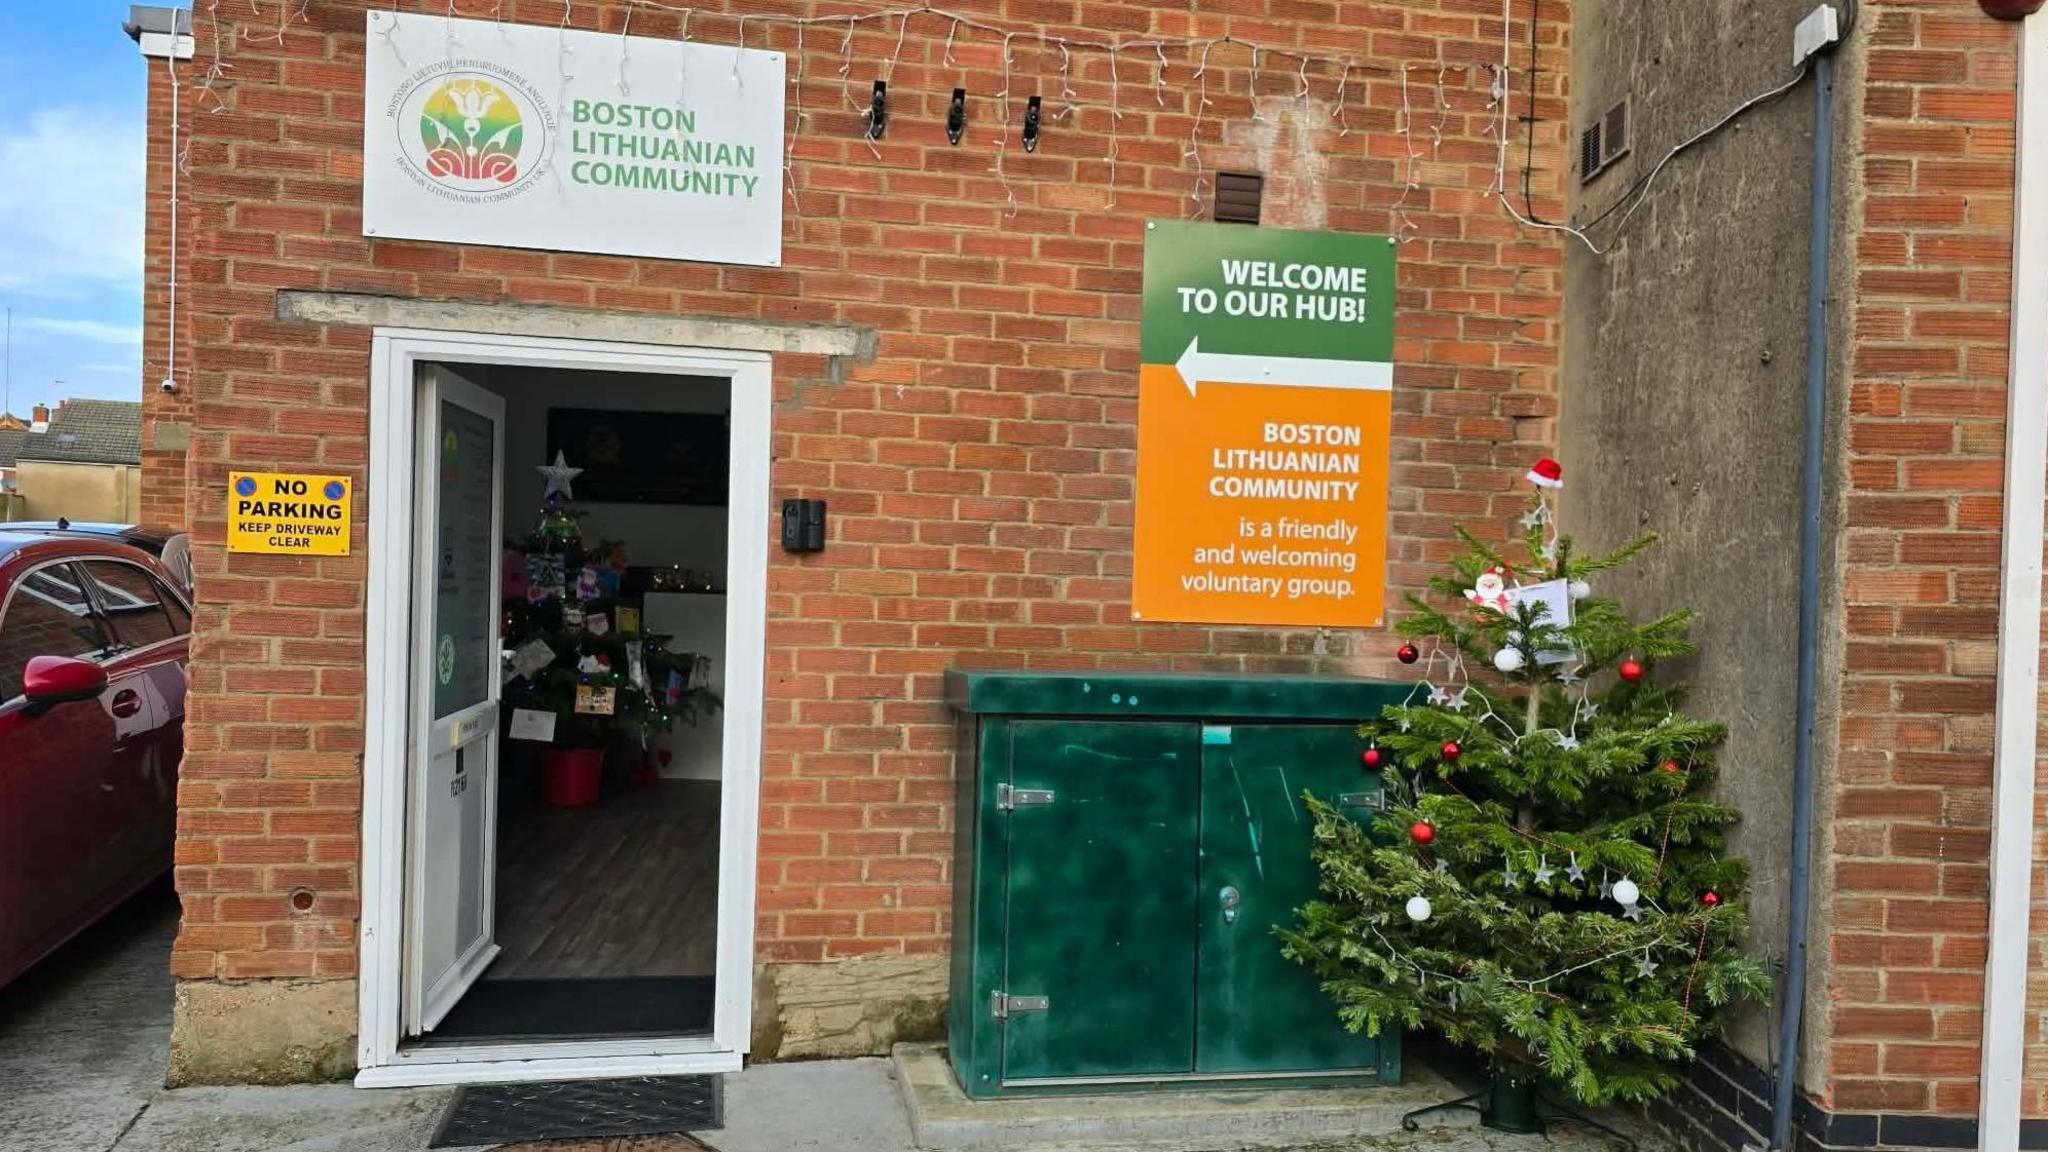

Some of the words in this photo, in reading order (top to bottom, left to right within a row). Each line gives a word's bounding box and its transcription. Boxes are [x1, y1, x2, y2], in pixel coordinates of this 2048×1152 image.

[573, 100, 695, 133] BOSTON
[573, 130, 755, 168] LITHUANIAN
[396, 156, 426, 187] BOSTON
[426, 184, 481, 204] LITHUANIAN
[483, 180, 534, 203] COMMUNITY
[571, 160, 759, 198] COMMUNITY
[1221, 259, 1367, 293] WELCOME
[1177, 287, 1218, 314] TO
[1224, 290, 1288, 318] OUR
[1295, 294, 1366, 323] HUB!
[1263, 422, 1361, 446] BOSTON
[1213, 448, 1360, 474] LITHUANIAN
[275, 479, 308, 496] NO
[1209, 476, 1359, 502] COMMUNITY
[238, 500, 342, 520] PARKING
[238, 522, 272, 533] KEEP
[276, 523, 342, 536] DRIVEWAY
[268, 536, 311, 548] CLEAR
[1239, 516, 1255, 537] is
[1260, 522, 1272, 537] a
[1277, 516, 1358, 546] friendly
[1194, 543, 1235, 564] and
[1241, 544, 1356, 573] welcoming
[1181, 570, 1282, 598] voluntary
[1287, 577, 1355, 600] group.
